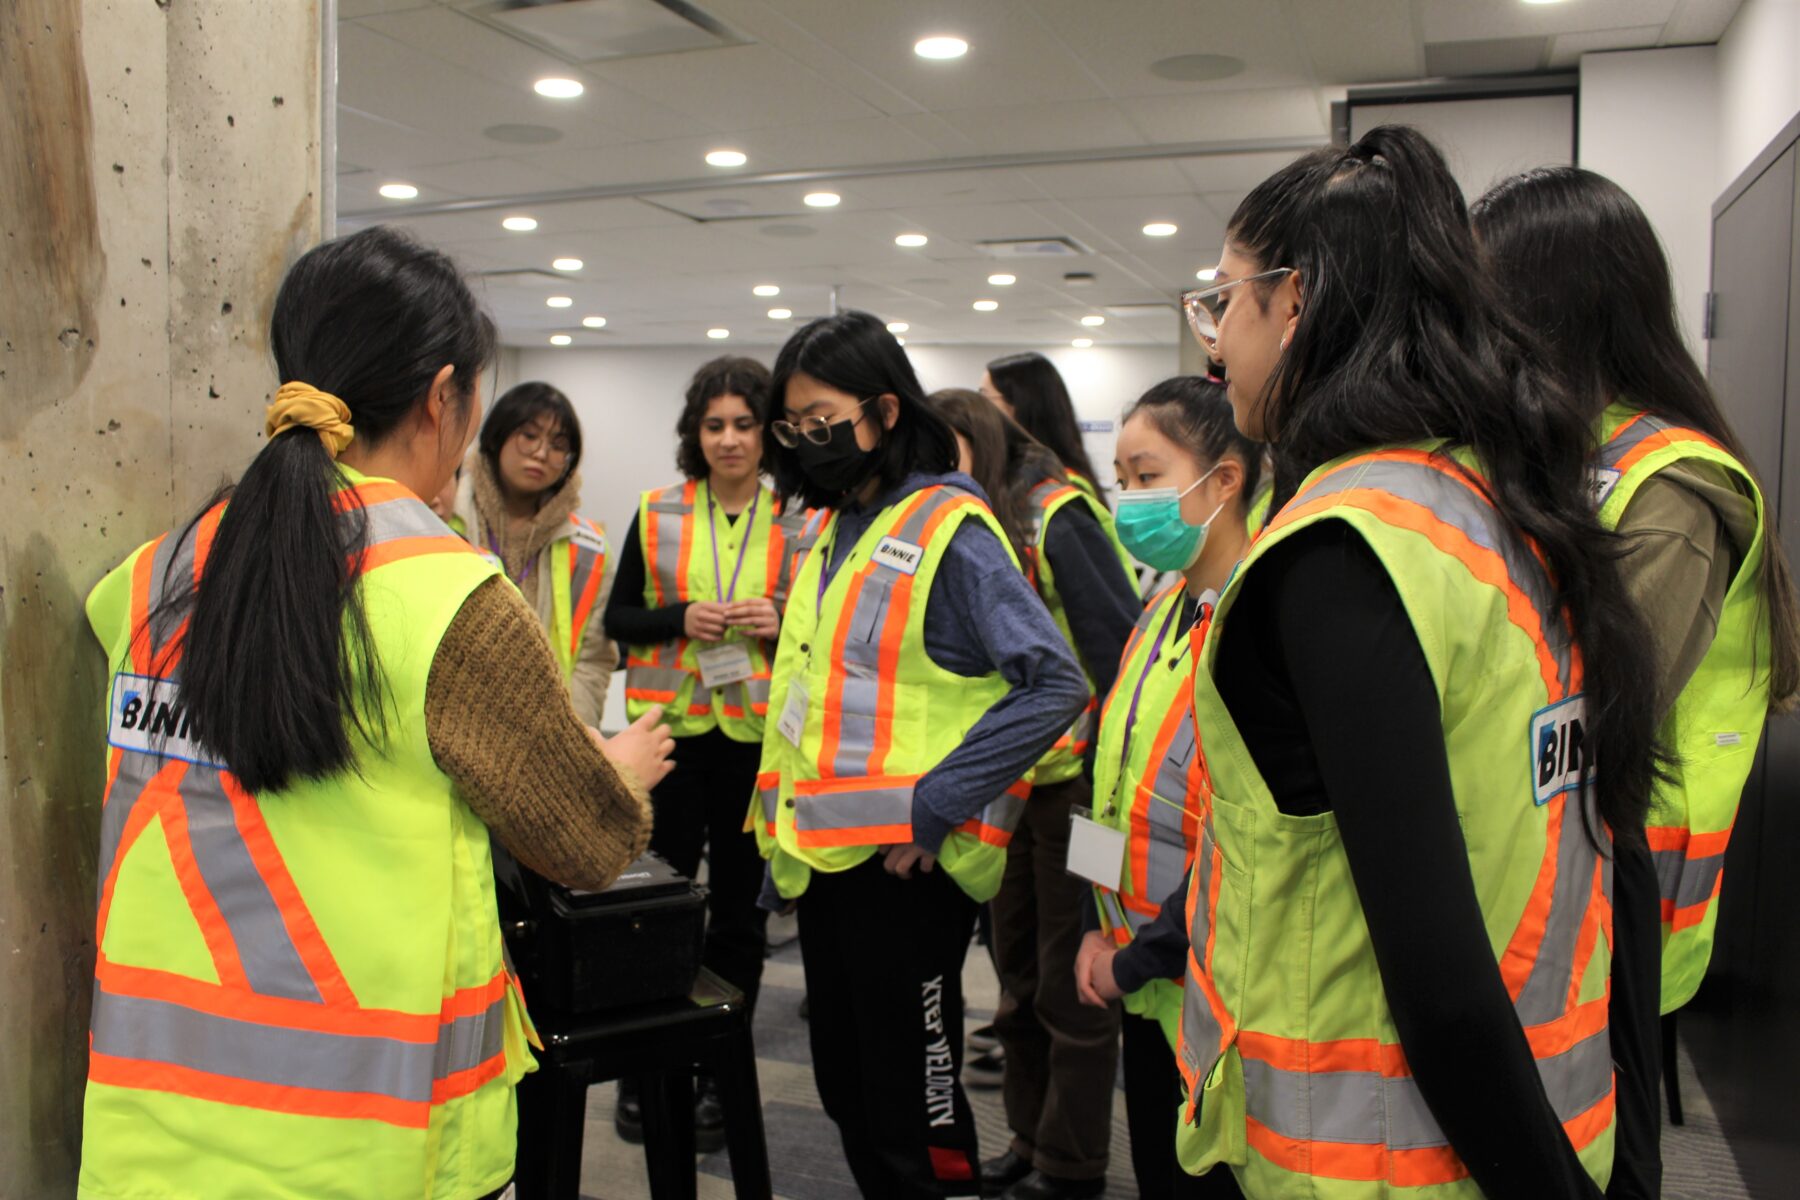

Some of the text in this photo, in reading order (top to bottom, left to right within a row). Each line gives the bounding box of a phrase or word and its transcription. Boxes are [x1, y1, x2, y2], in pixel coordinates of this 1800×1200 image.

[880, 543, 916, 564] BINNIE
[922, 974, 955, 1127] XTEP VELOCITY
